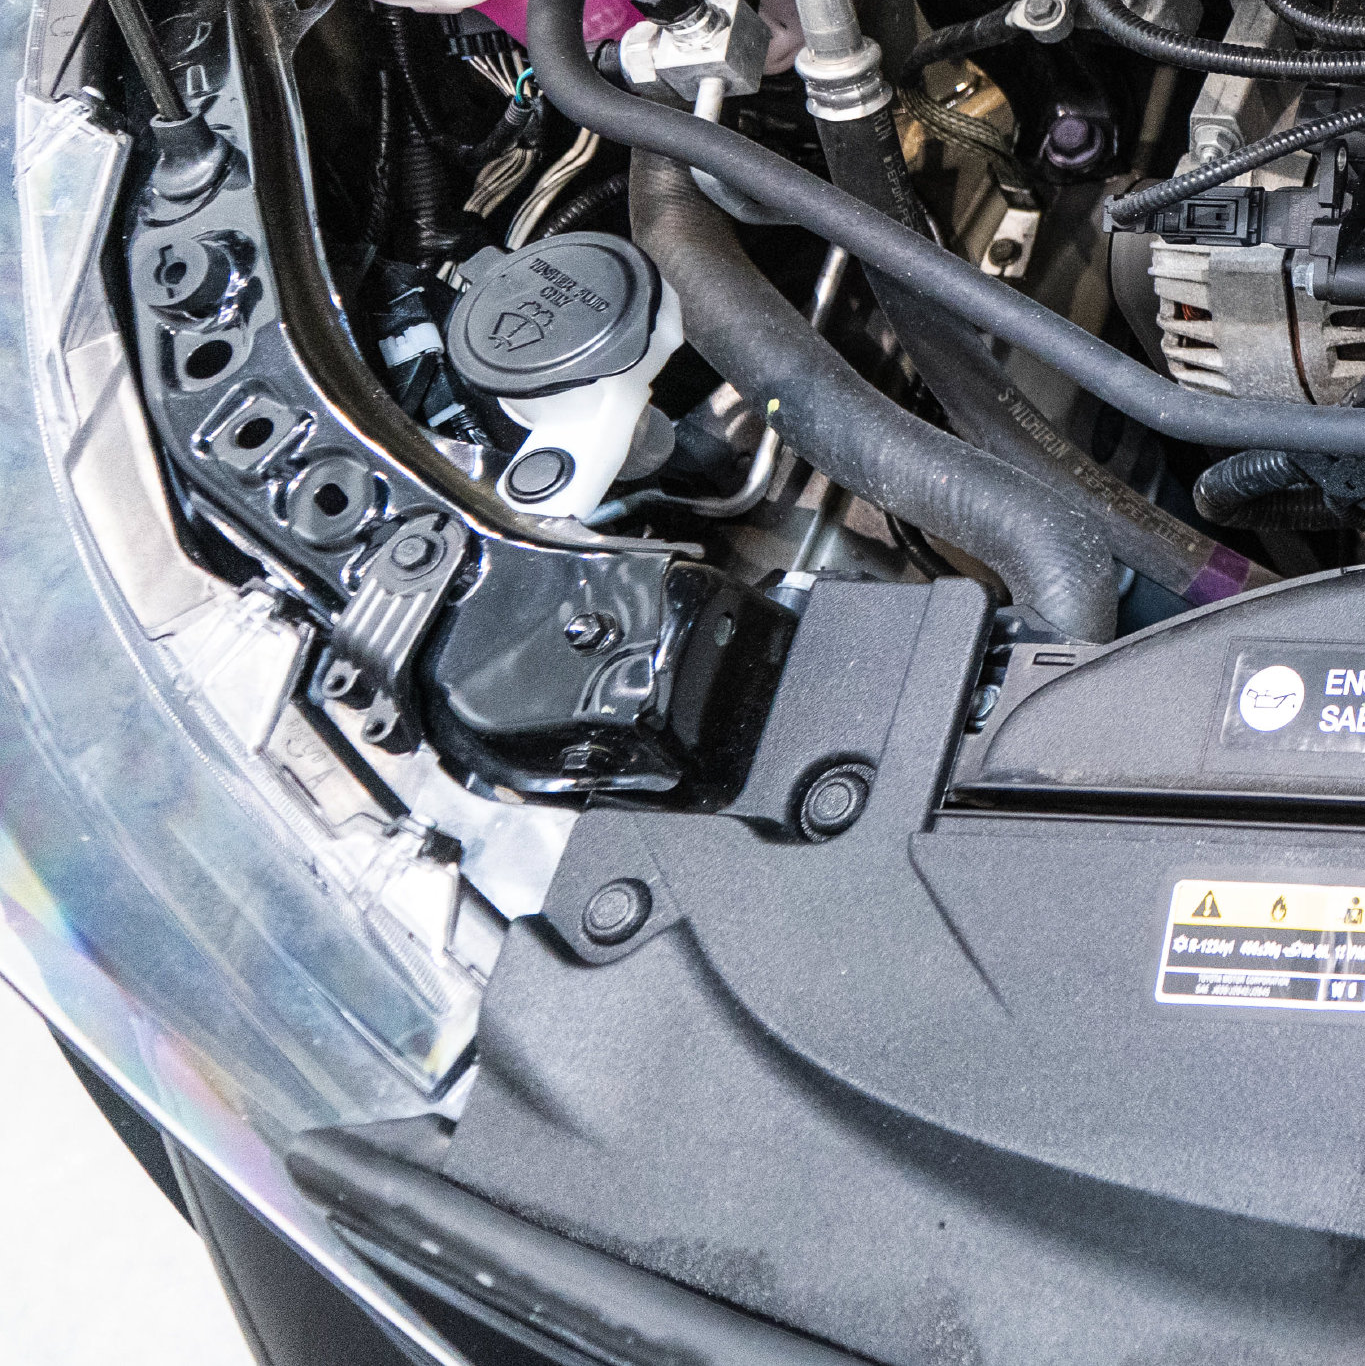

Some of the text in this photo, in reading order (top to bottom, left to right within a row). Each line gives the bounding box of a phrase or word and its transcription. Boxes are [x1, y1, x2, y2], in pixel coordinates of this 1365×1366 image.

[529, 258, 609, 312] WASHER FLUID
[540, 285, 575, 308] ONLY
